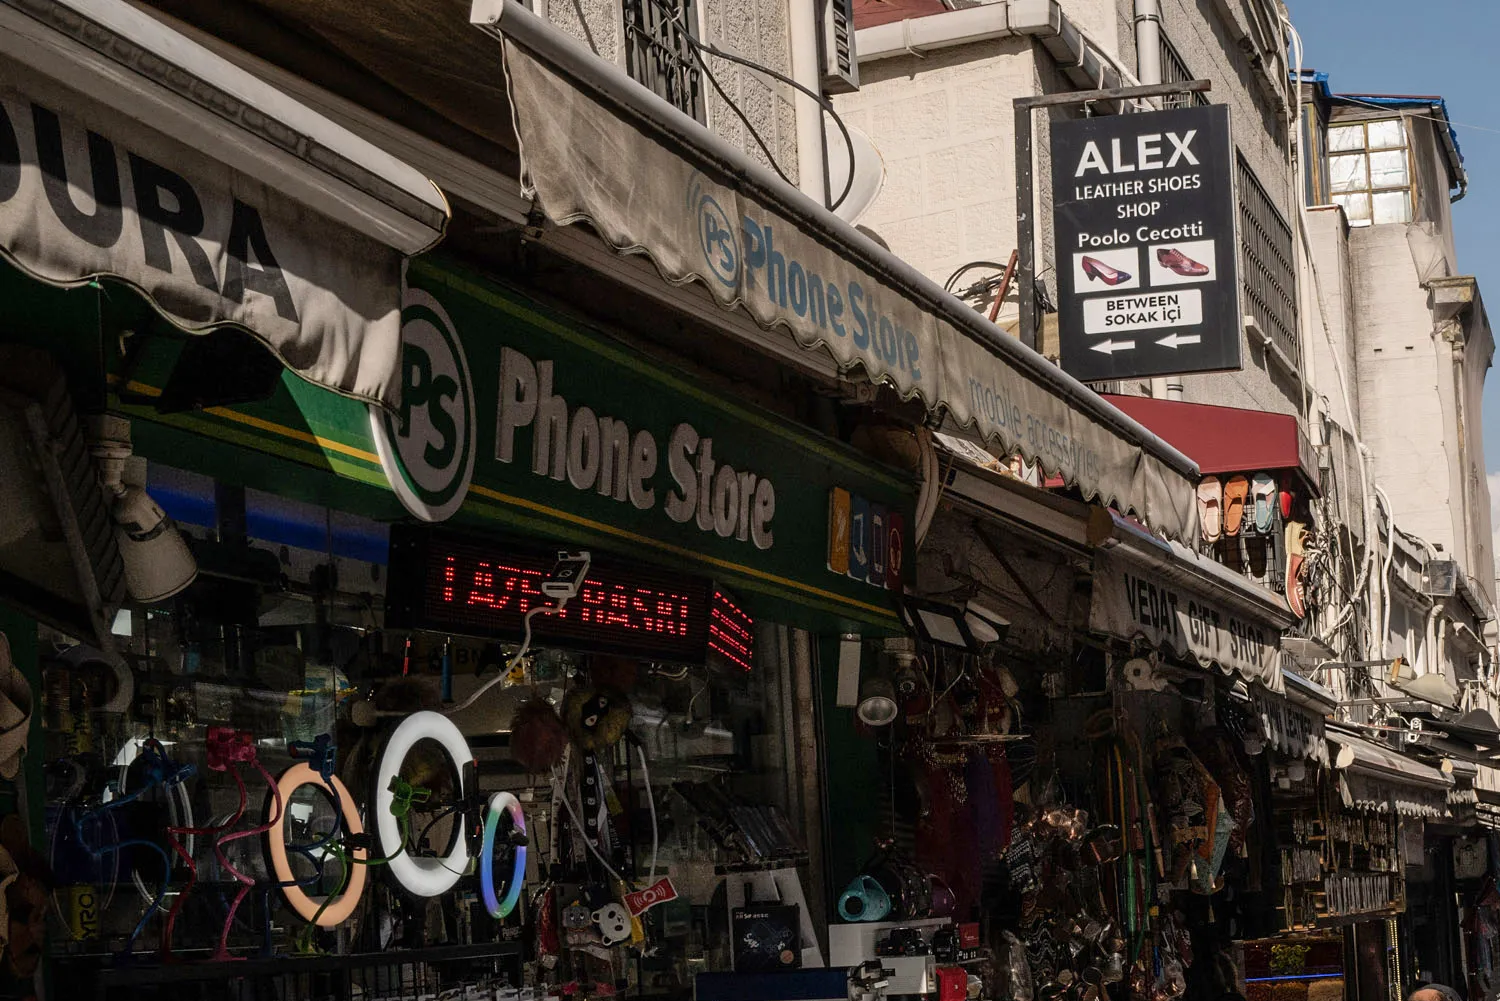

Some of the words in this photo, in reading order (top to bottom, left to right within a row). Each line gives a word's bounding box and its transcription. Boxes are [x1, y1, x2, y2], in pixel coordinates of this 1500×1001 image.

[1074, 129, 1200, 177] ALEX
[1075, 180, 1144, 200] LEATHER
[1148, 174, 1201, 193] SHOES
[1117, 202, 1161, 218] SHOP
[0, 100, 300, 326] URA
[1078, 229, 1130, 248] Poolo
[1136, 221, 1203, 242] Cecotti
[704, 212, 735, 273] PS
[743, 215, 847, 338] Phone
[847, 280, 922, 381] Store
[1105, 311, 1158, 326] SOKAK
[1162, 306, 1182, 324] İÇİ
[1106, 294, 1179, 312] BETWEEN
[968, 377, 1023, 439] mobile
[400, 342, 459, 471] PS
[495, 345, 658, 510] Phone
[664, 422, 776, 551] Store
[1123, 572, 1178, 637] VEDAT
[1187, 599, 1221, 653] GIFT
[1229, 617, 1265, 668] SHOP
